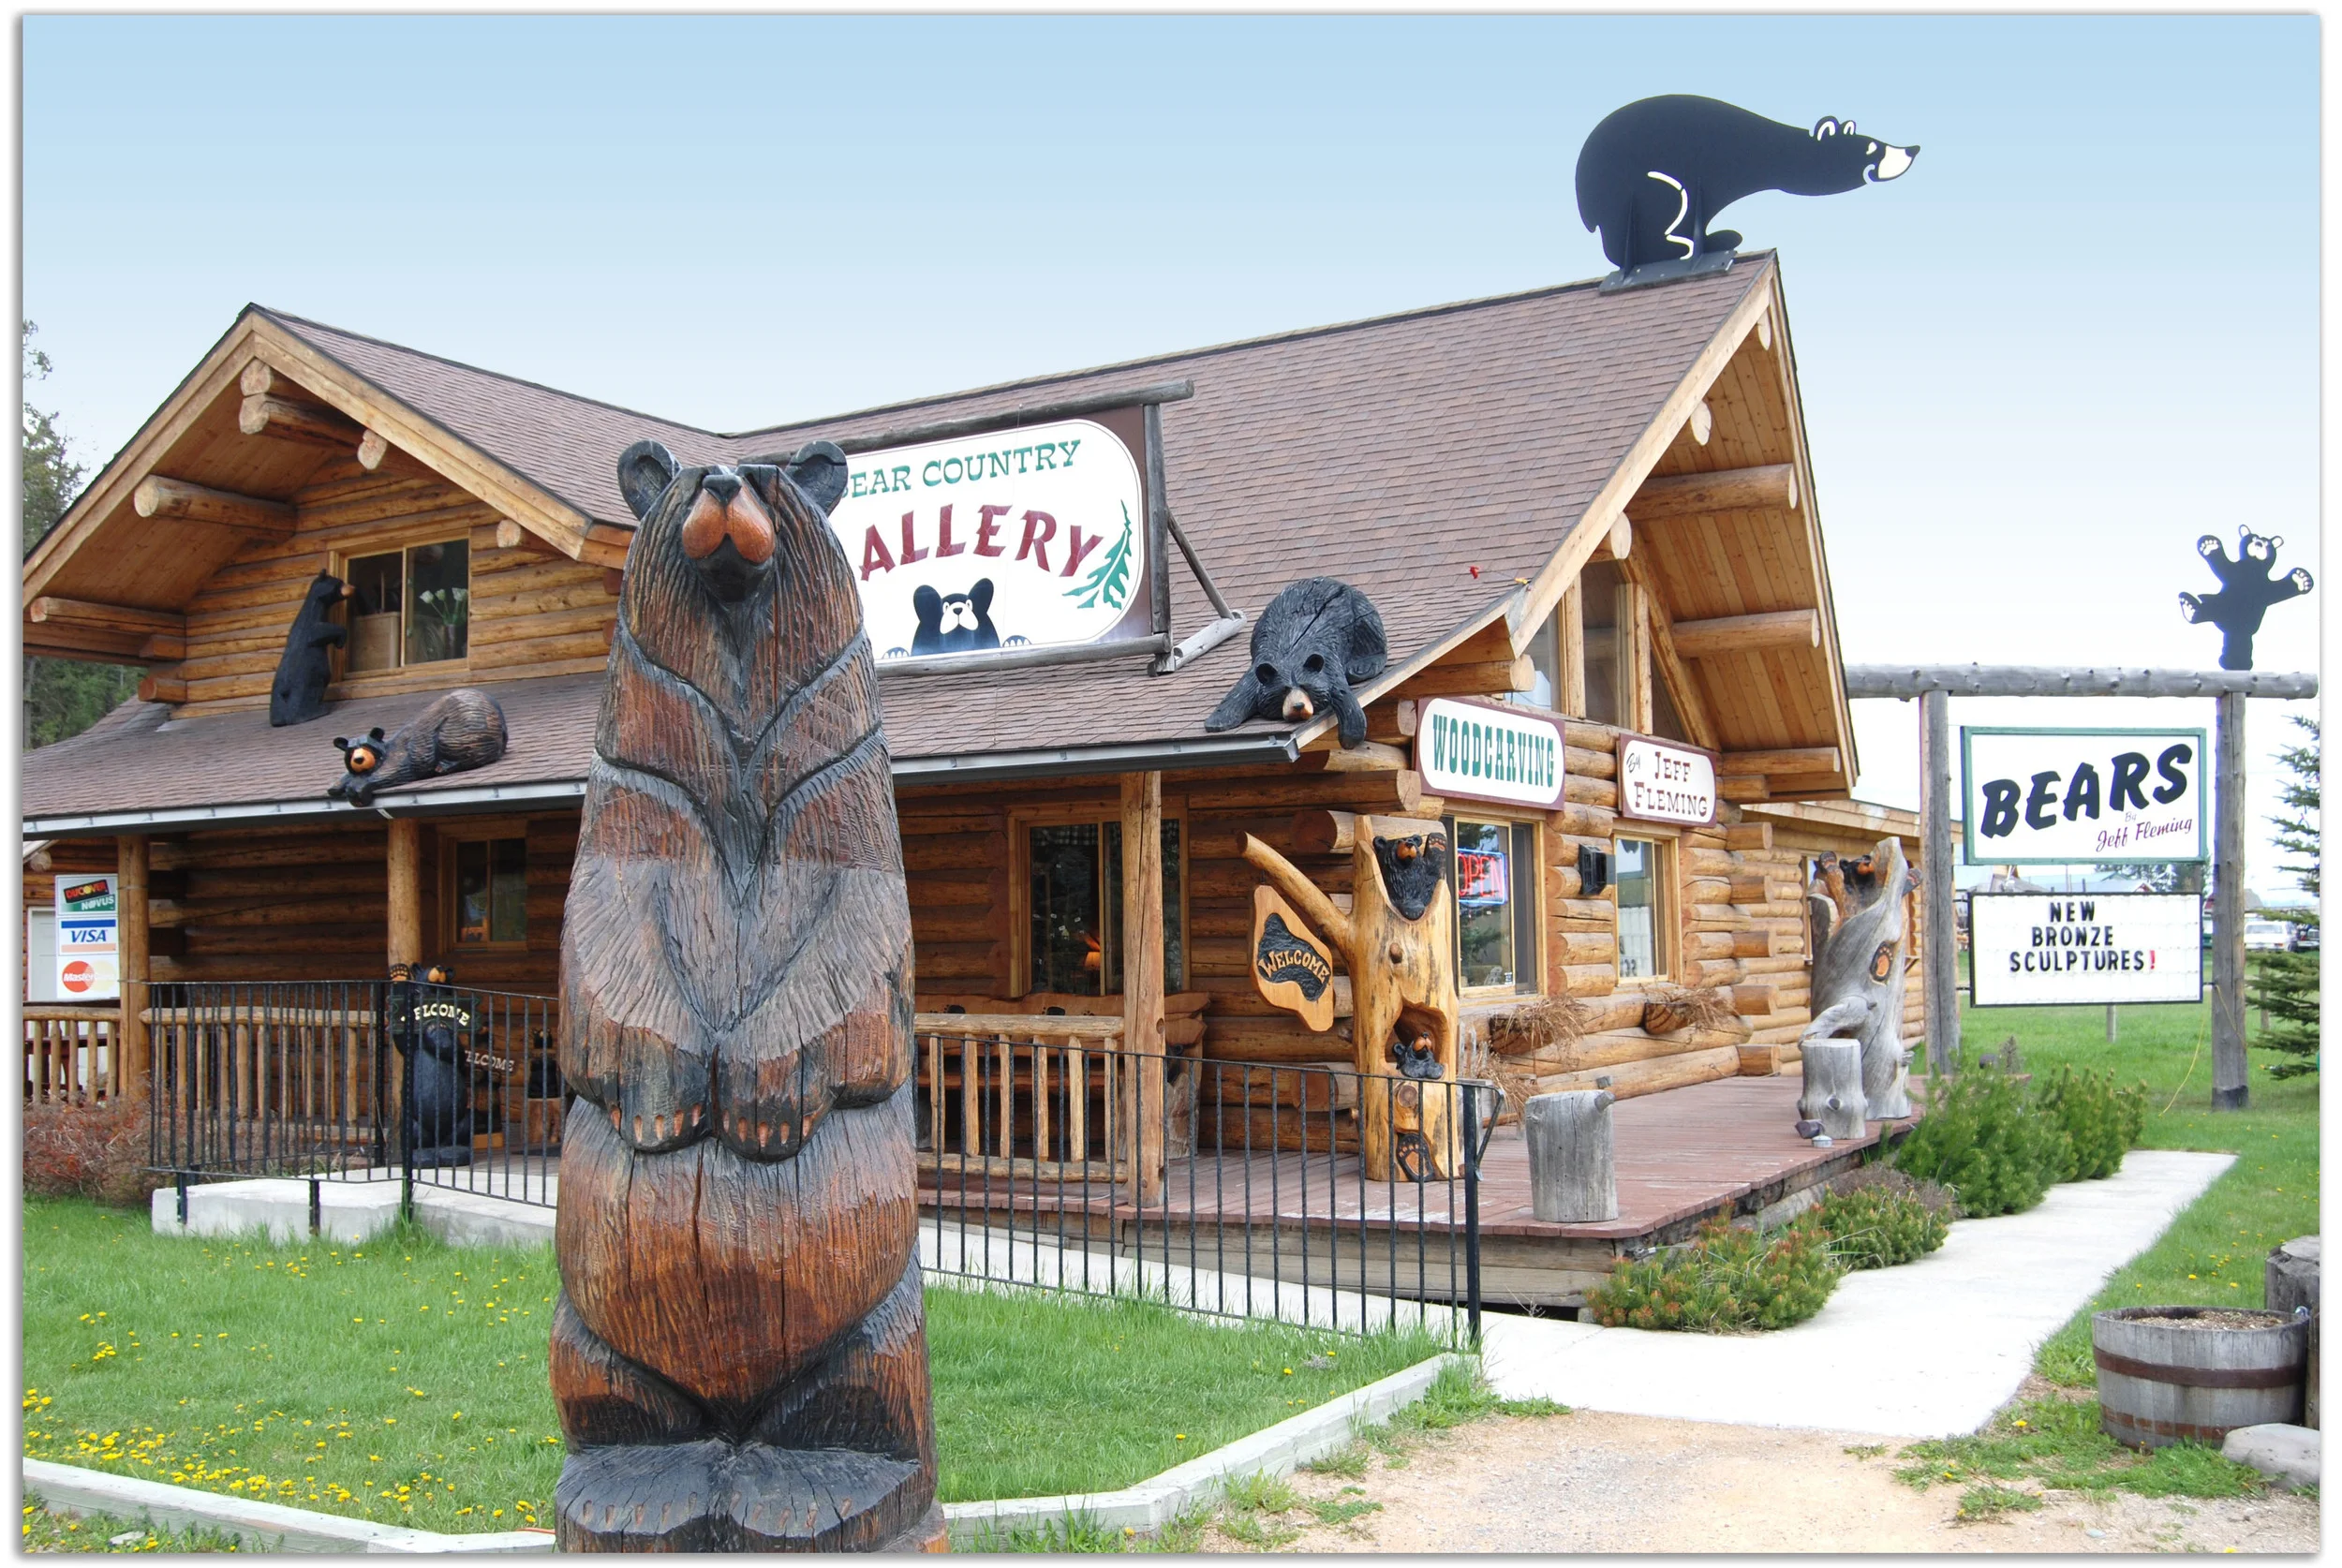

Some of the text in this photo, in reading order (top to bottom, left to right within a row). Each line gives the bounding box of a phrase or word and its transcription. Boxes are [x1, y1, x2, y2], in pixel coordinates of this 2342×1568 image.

[842, 438, 1081, 498] EAR COUNTRY
[858, 503, 1104, 583] ALLERY
[1432, 713, 1555, 789] WOODCARVING
[1979, 743, 2193, 839] BEARS
[2096, 817, 2193, 852] Jeff Fleming
[1458, 851, 1504, 899] OPEN
[81, 895, 115, 911] NOVUS
[2049, 900, 2096, 923] NEW
[70, 929, 108, 943] VISA
[2031, 925, 2114, 947] BRONZE
[1257, 949, 1330, 984] WELCOME
[2009, 950, 2156, 972] SCULPTURES!
[63, 972, 114, 984] Master
[400, 1003, 470, 1027] ELCOME
[464, 1050, 515, 1072] ELCOME
